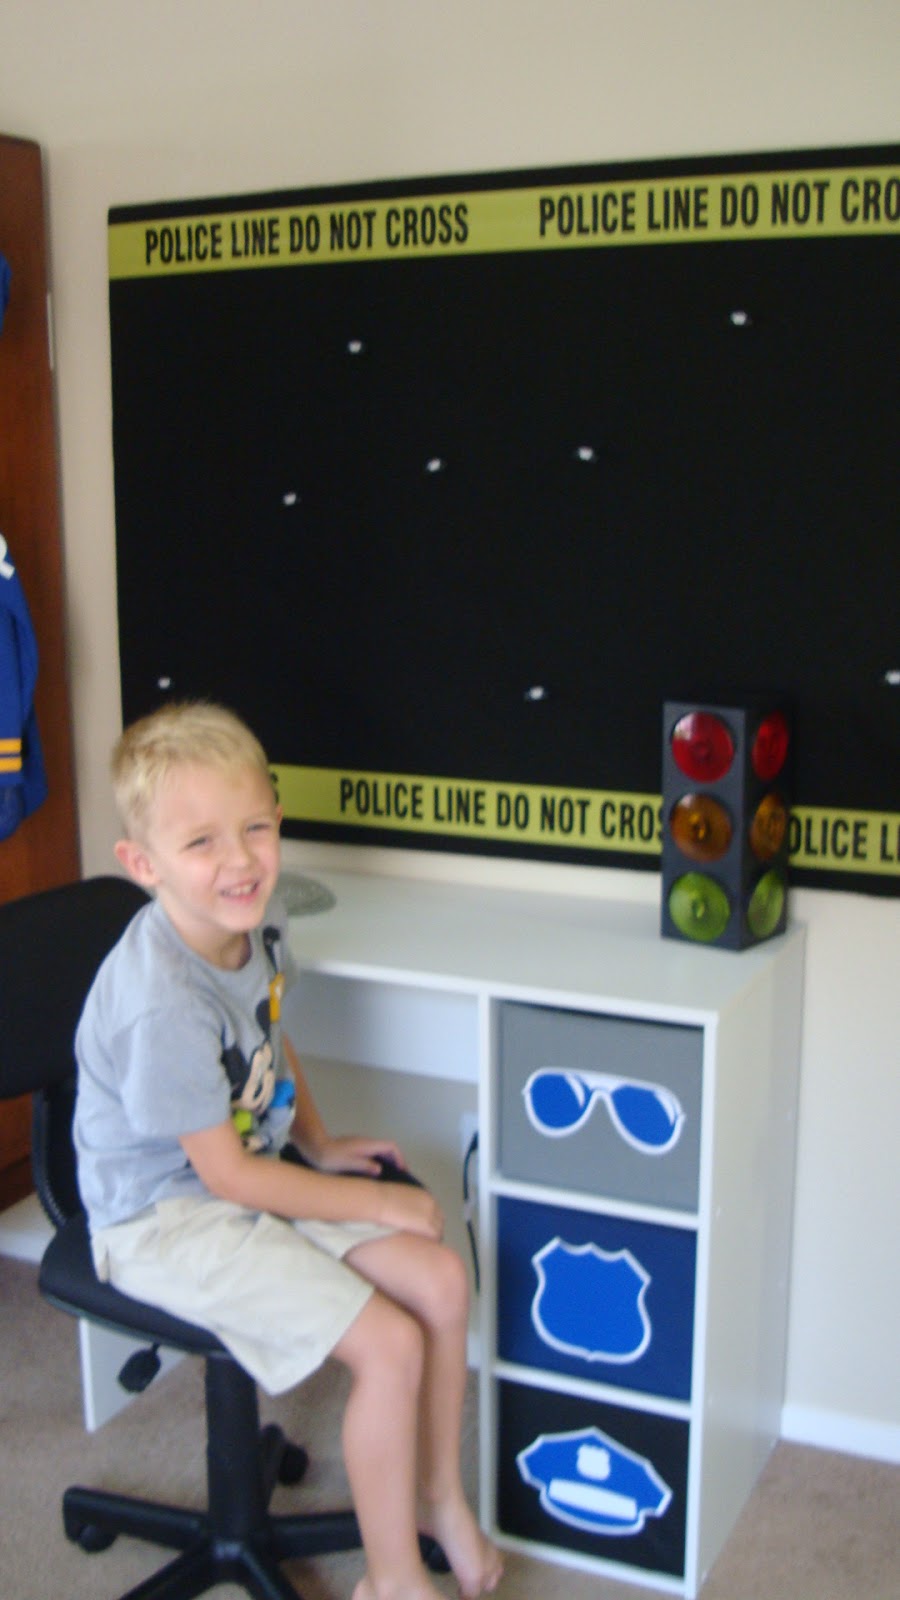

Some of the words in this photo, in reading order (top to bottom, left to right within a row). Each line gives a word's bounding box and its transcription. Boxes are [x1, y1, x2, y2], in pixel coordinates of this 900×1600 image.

[144, 222, 222, 265] POLICE
[231, 215, 280, 258] LINE
[290, 213, 320, 255] DO
[330, 210, 376, 251] NOT
[386, 202, 469, 247] CROSS
[539, 191, 635, 237] POLICE
[647, 185, 708, 231] LINE
[720, 183, 759, 228] DO
[771, 180, 830, 225] NOT
[340, 777, 424, 819] POLICE
[433, 786, 485, 825] LINE
[497, 791, 530, 831] DO
[540, 797, 590, 835] NOT
